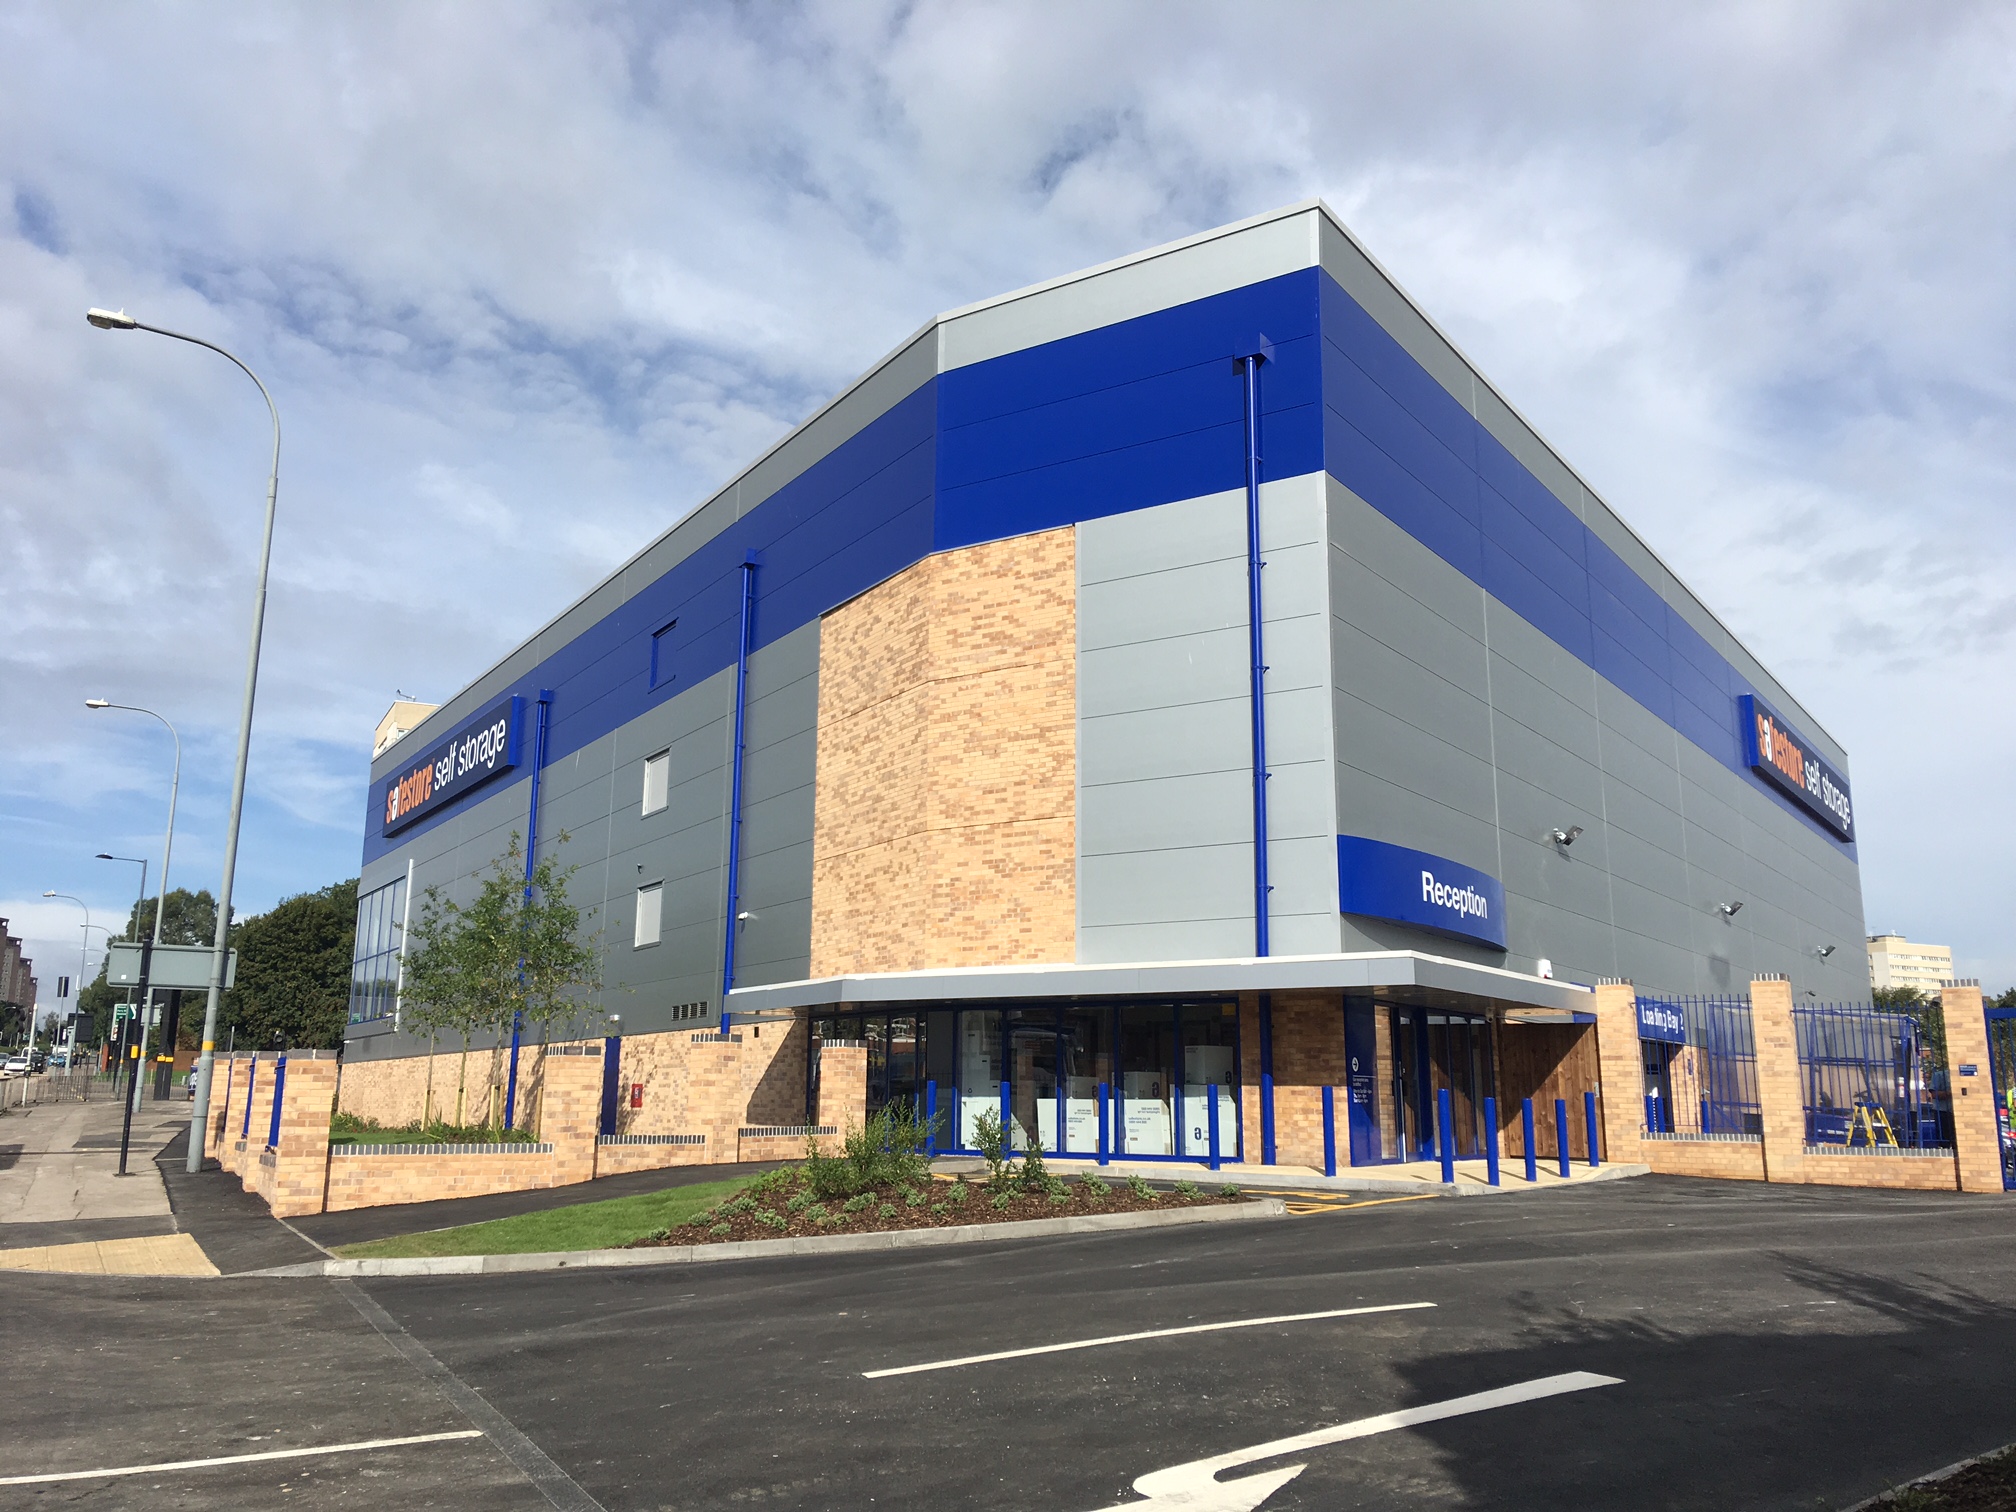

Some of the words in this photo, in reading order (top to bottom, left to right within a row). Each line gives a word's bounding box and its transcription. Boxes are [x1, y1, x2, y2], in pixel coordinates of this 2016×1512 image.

[386, 763, 433, 824] safestore
[434, 741, 457, 791] self
[457, 718, 506, 776] storage
[1757, 713, 1805, 789] safestore
[1805, 760, 1822, 799] self
[1822, 773, 1851, 831] storage
[1421, 870, 1488, 920] Reception
[1667, 1009, 1679, 1035] Bay
